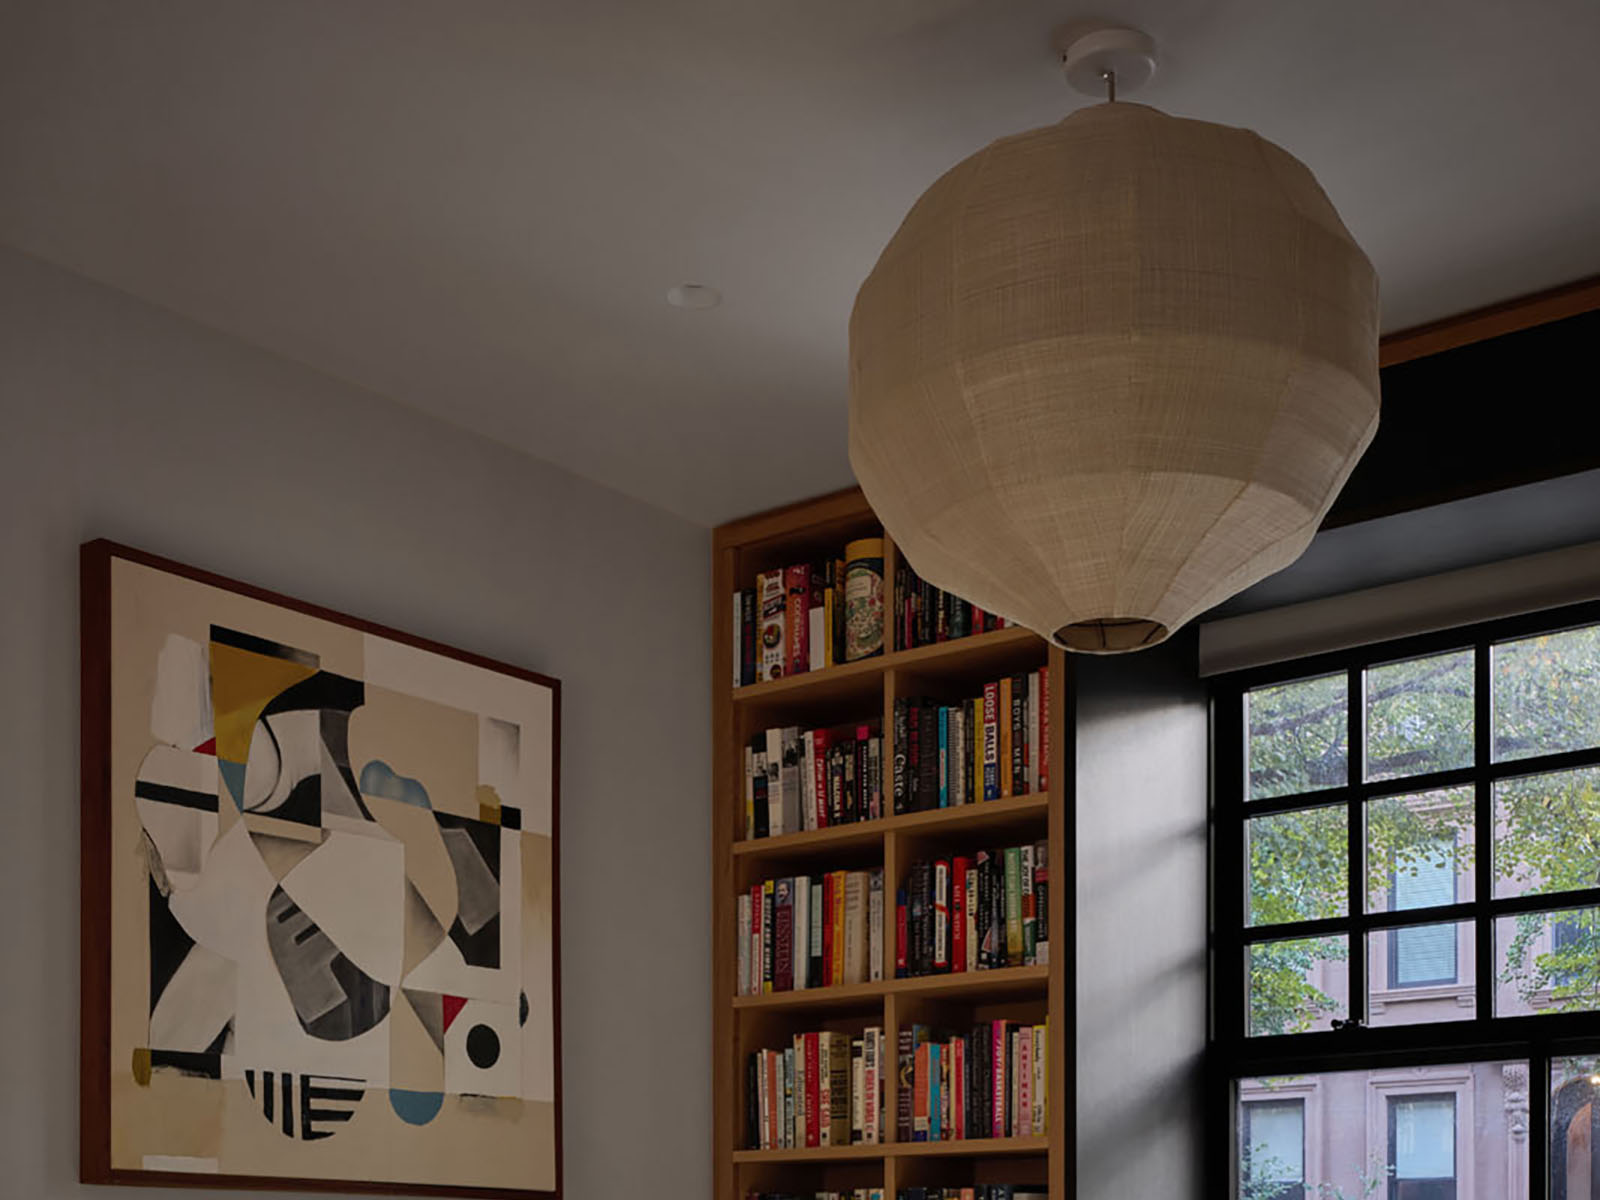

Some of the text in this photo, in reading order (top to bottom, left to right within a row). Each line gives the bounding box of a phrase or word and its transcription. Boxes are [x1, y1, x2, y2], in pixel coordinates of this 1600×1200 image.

[985, 685, 995, 761] LOOSE BALLS
[1013, 699, 1021, 774] BOYS MEN
[894, 754, 906, 797] Caste
